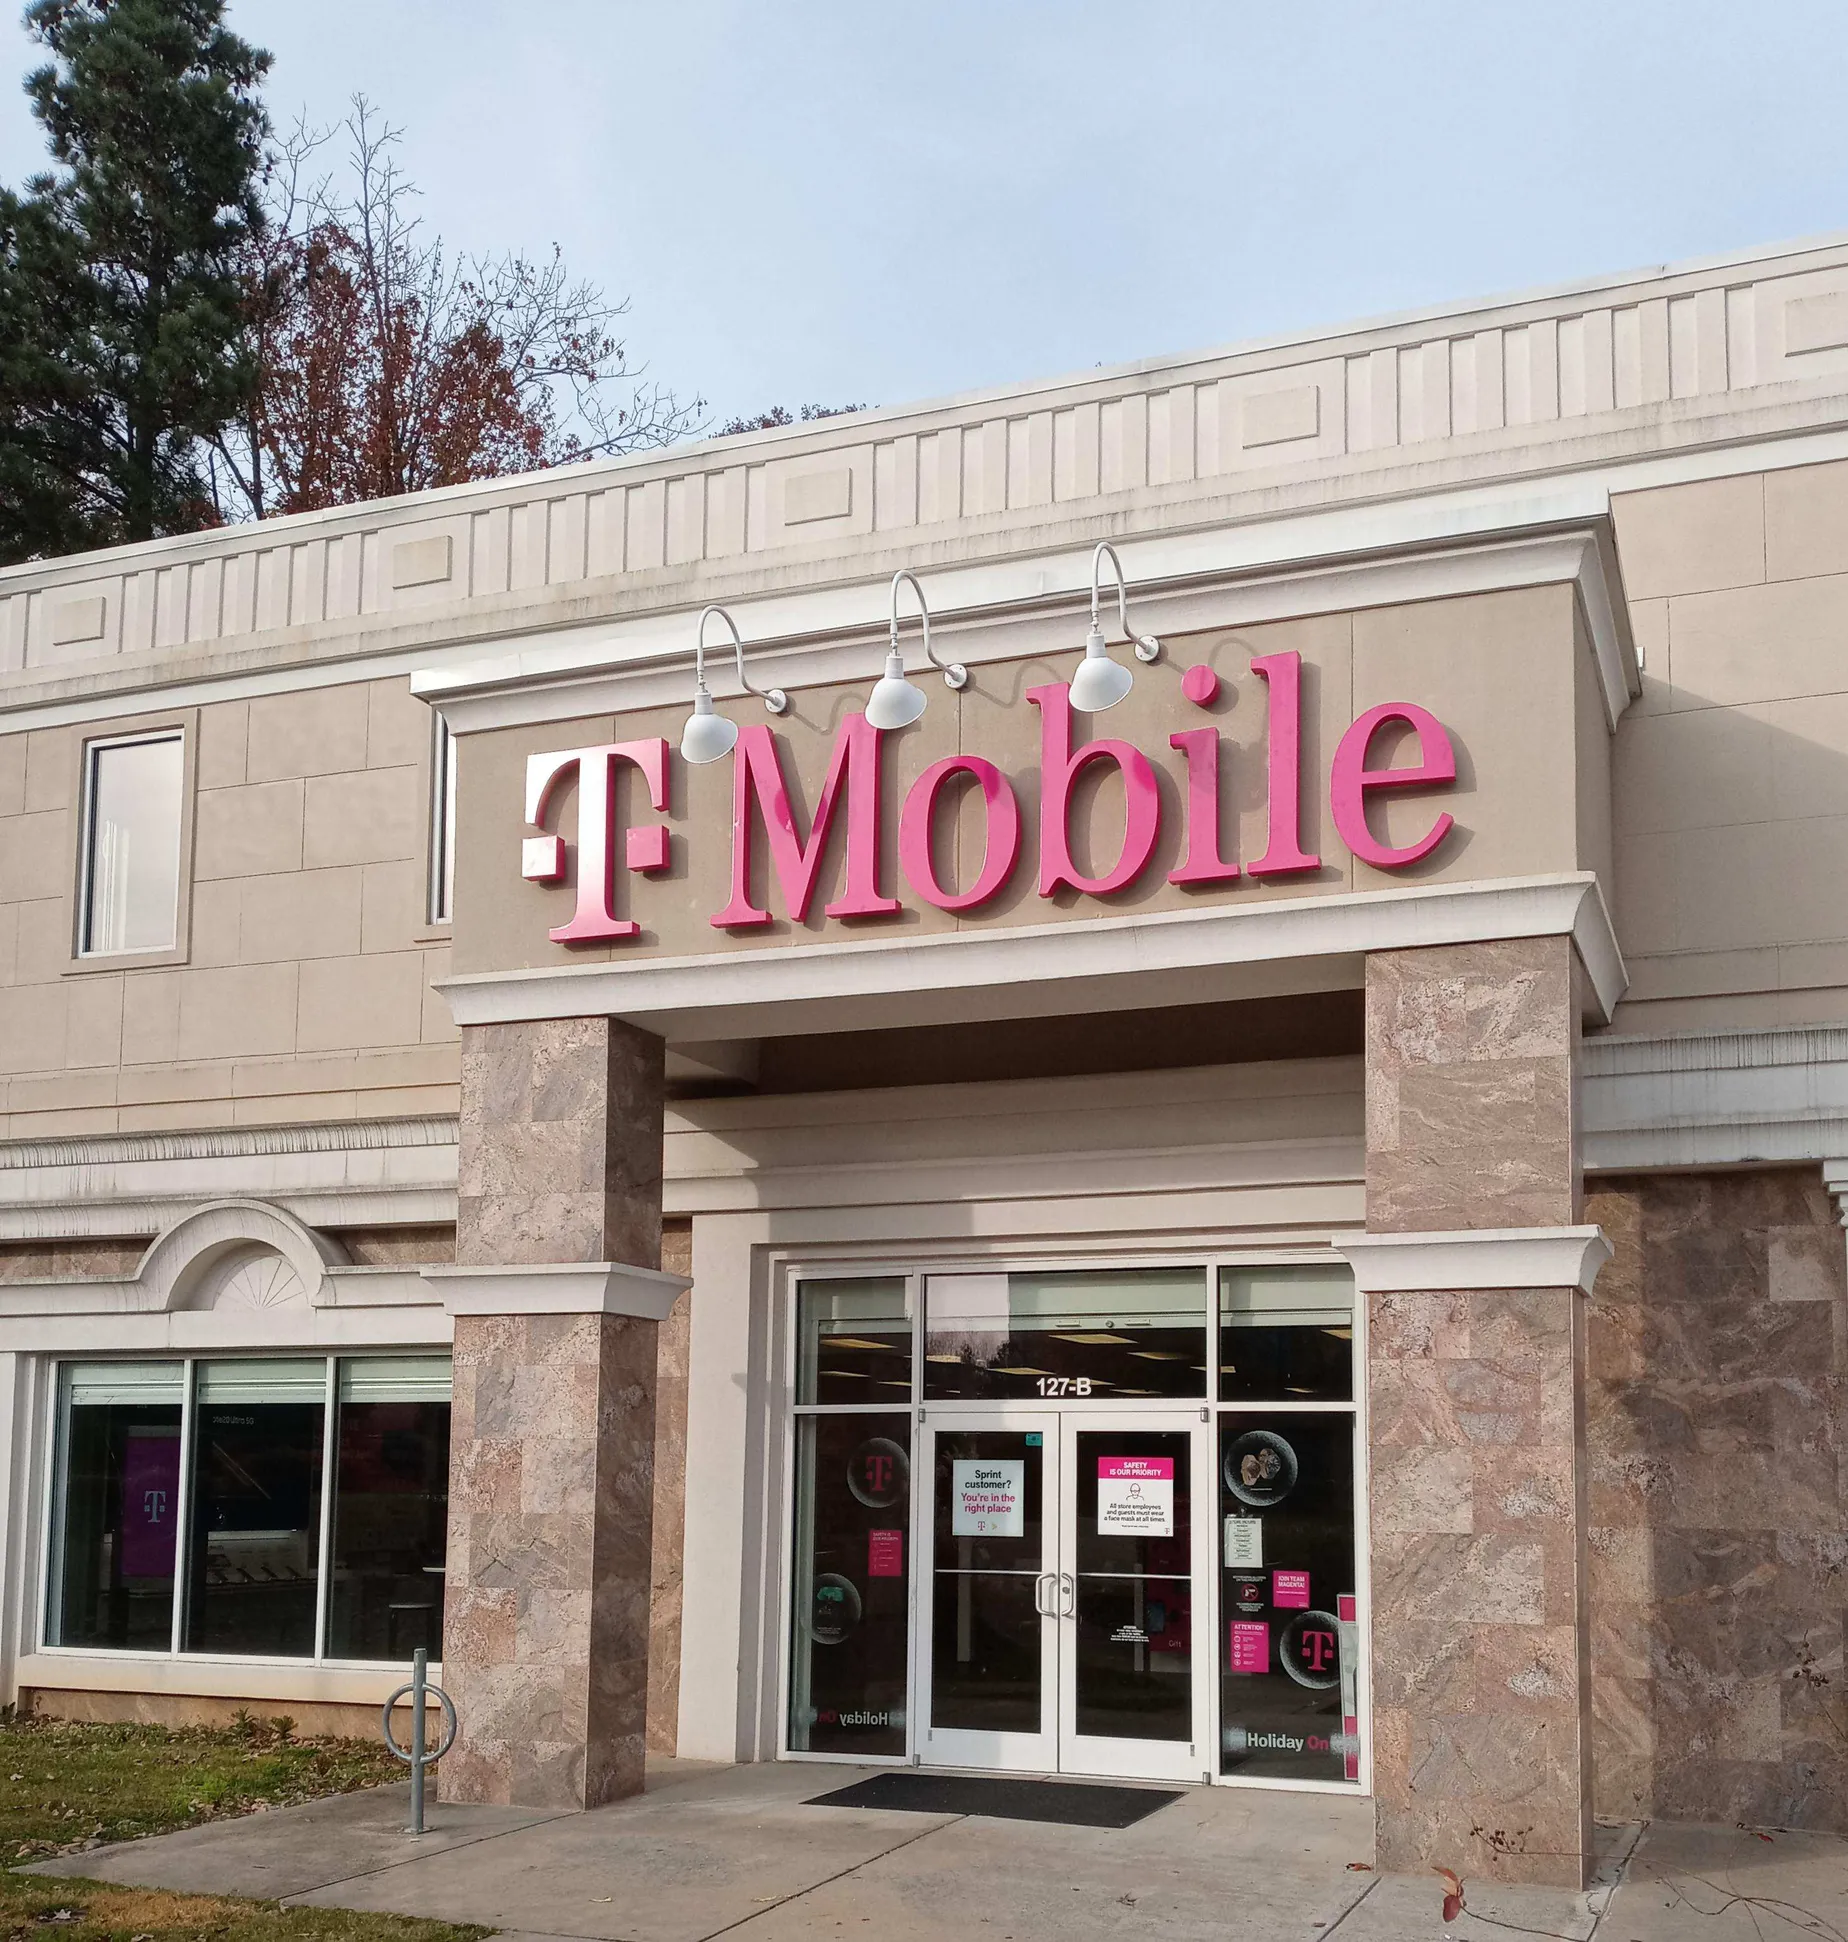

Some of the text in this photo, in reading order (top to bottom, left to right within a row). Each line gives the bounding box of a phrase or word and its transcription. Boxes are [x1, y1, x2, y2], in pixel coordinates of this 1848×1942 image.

[1036, 1377, 1092, 1396] 127-B
[1123, 1461, 1148, 1469] SAFETY
[975, 1469, 1002, 1480] Sprint
[1109, 1468, 1117, 1476] IS
[1131, 1469, 1162, 1477] PRIORITY
[965, 1480, 1012, 1489] customer?
[961, 1492, 1016, 1502] You're in the
[144, 1490, 166, 1523] T
[964, 1503, 1012, 1514] right place
[1247, 1732, 1329, 1752] Holiday On
